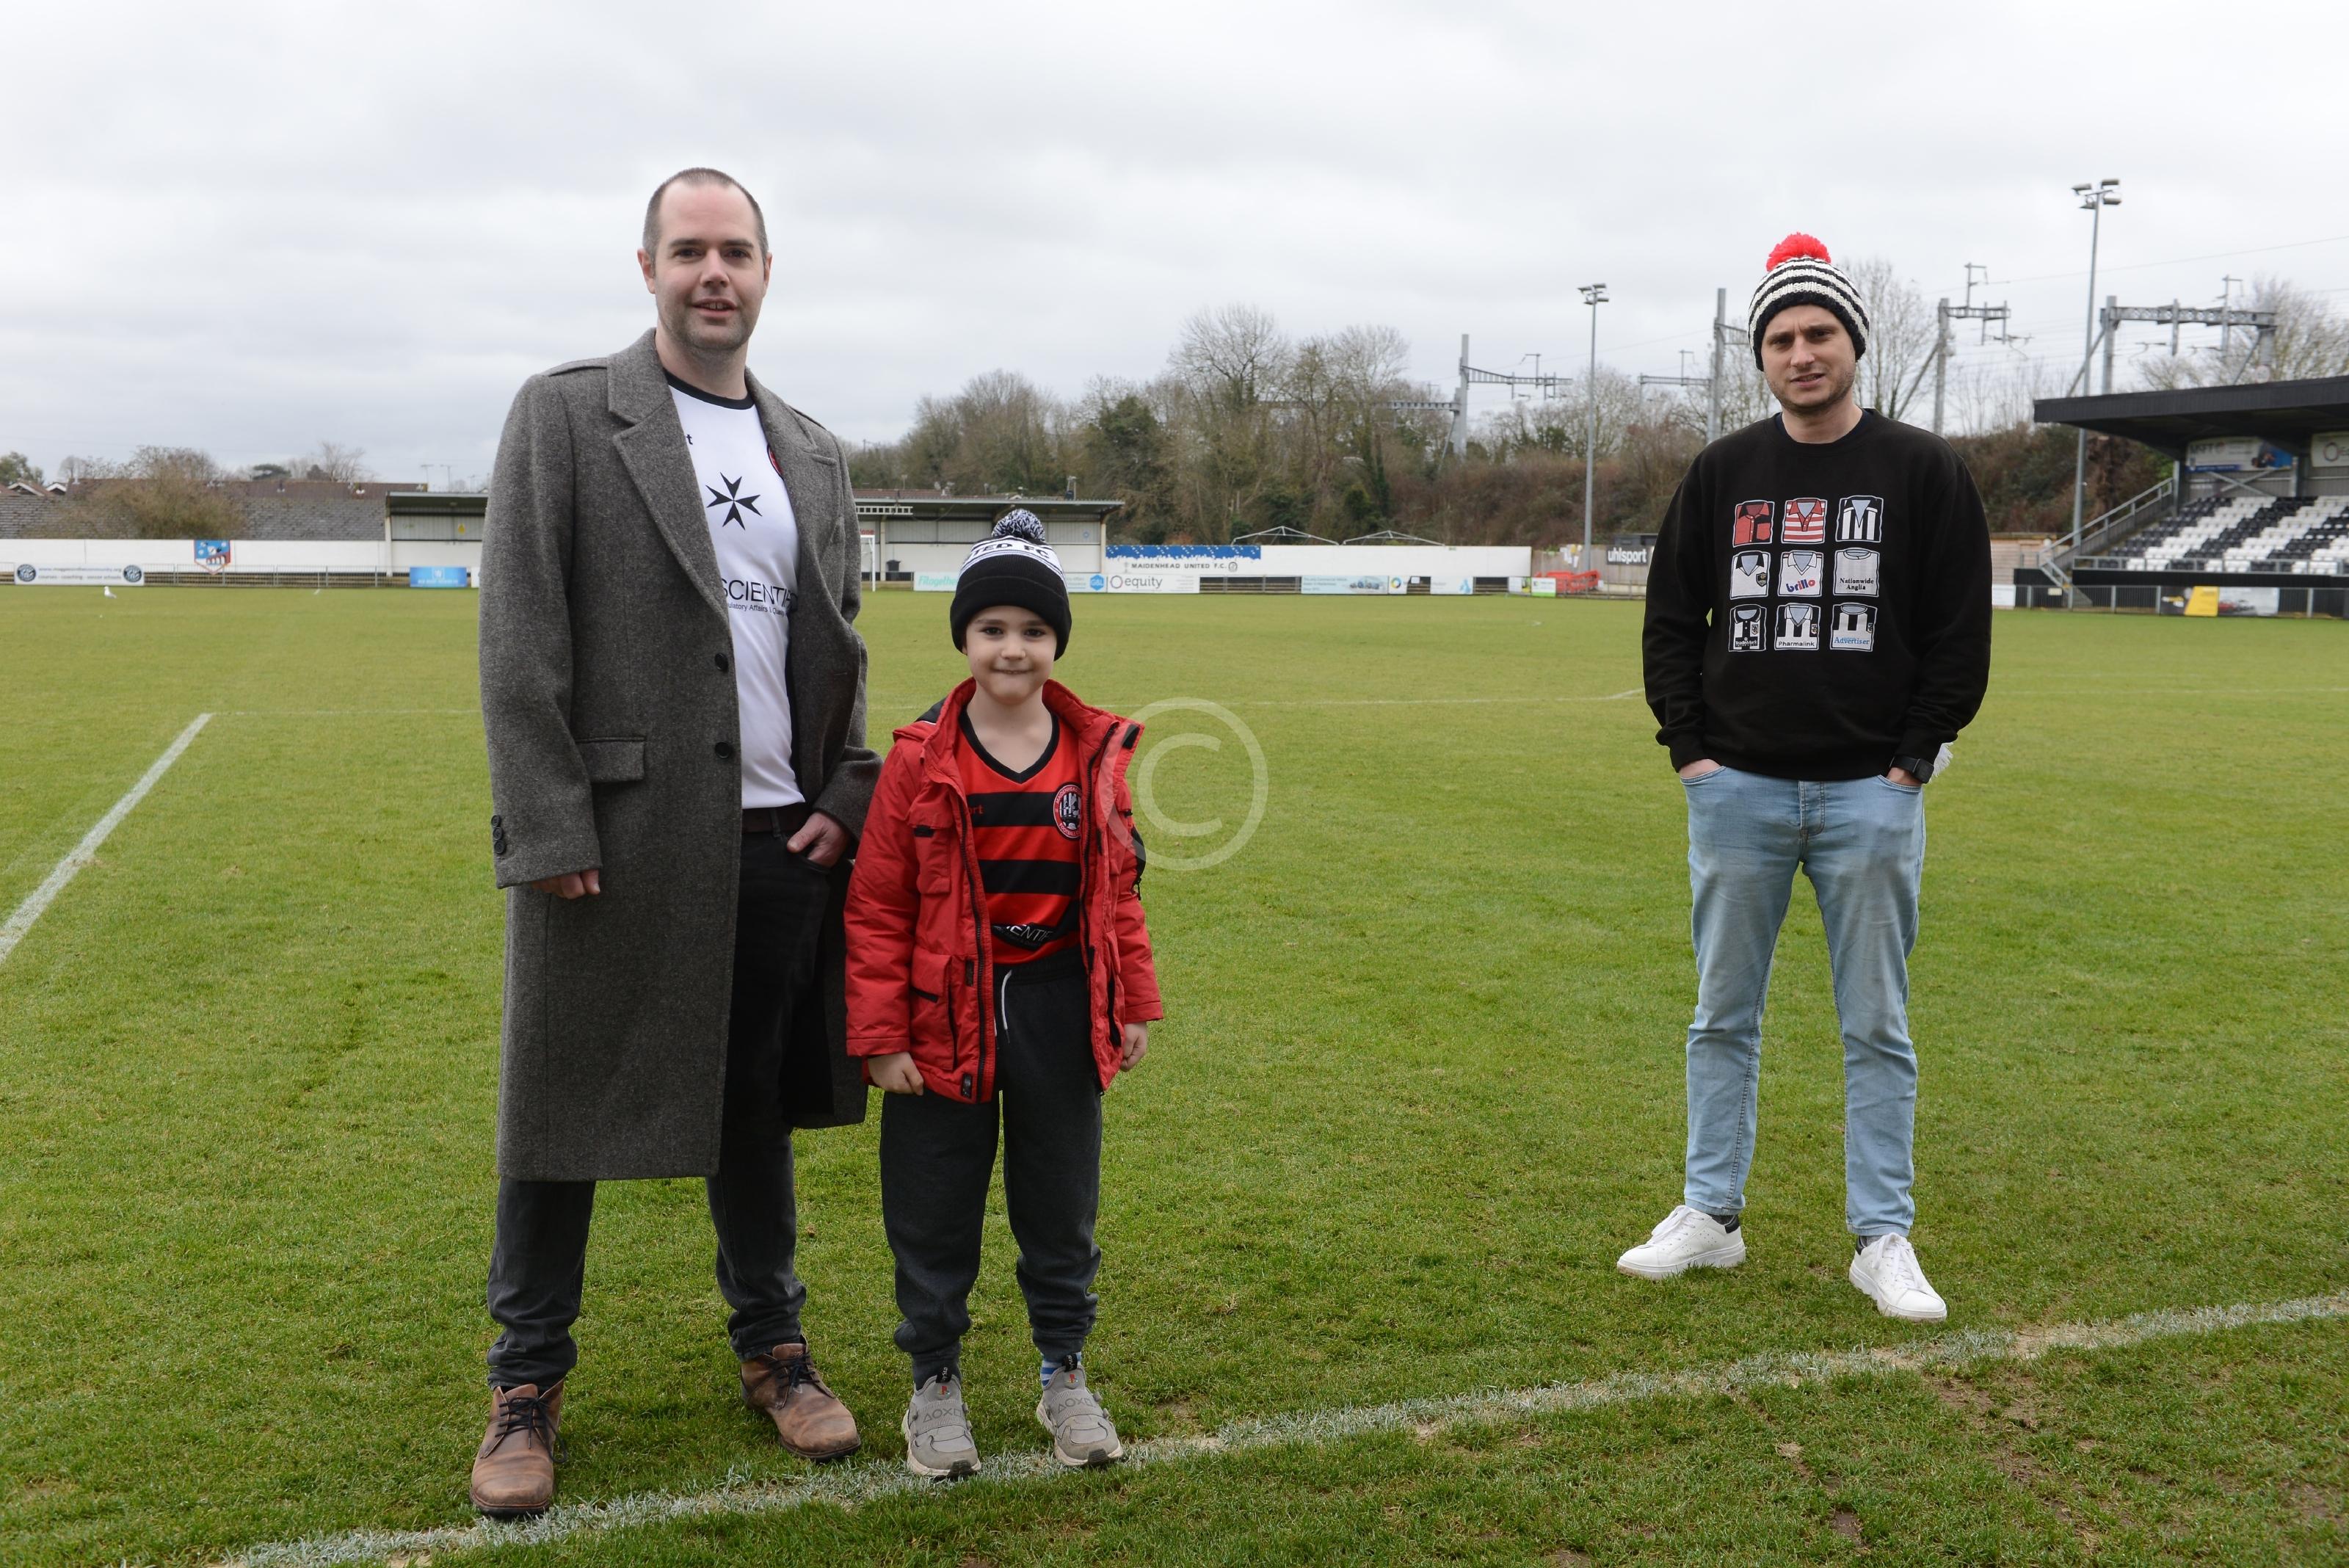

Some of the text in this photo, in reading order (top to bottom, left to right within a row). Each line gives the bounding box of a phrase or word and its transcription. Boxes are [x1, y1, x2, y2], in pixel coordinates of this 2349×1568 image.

[1608, 547, 1647, 564] uhlsport
[1125, 576, 1163, 589] equity
[1786, 579, 1815, 592] brillo
[1834, 636, 1870, 645] Advertiser
